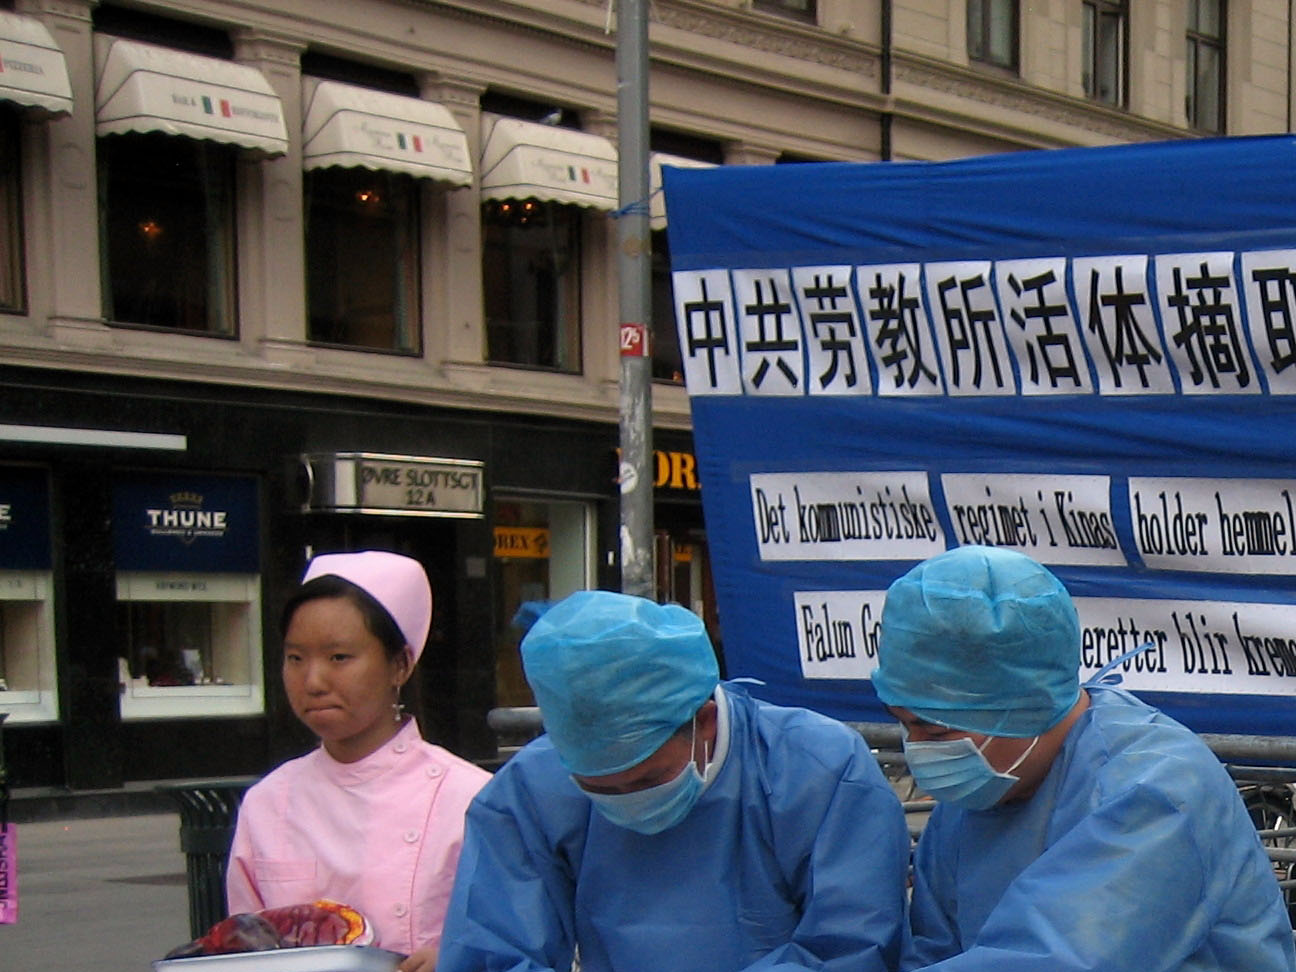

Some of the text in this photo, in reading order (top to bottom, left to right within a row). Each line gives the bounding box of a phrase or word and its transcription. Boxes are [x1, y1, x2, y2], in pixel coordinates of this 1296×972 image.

[361, 465, 400, 486] ØVRE
[147, 508, 227, 530] THUNE
[755, 487, 790, 544] Det
[794, 484, 937, 543] kommunistiske
[953, 485, 1038, 547] regimet
[1037, 489, 1058, 547] i
[1054, 490, 1118, 550] Kinas
[1134, 491, 1208, 556] holder
[494, 533, 530, 550] REX
[800, 601, 856, 662] Falun
[861, 603, 882, 659] Go
[1080, 617, 1168, 673] eretter
[1171, 612, 1233, 675] blir
